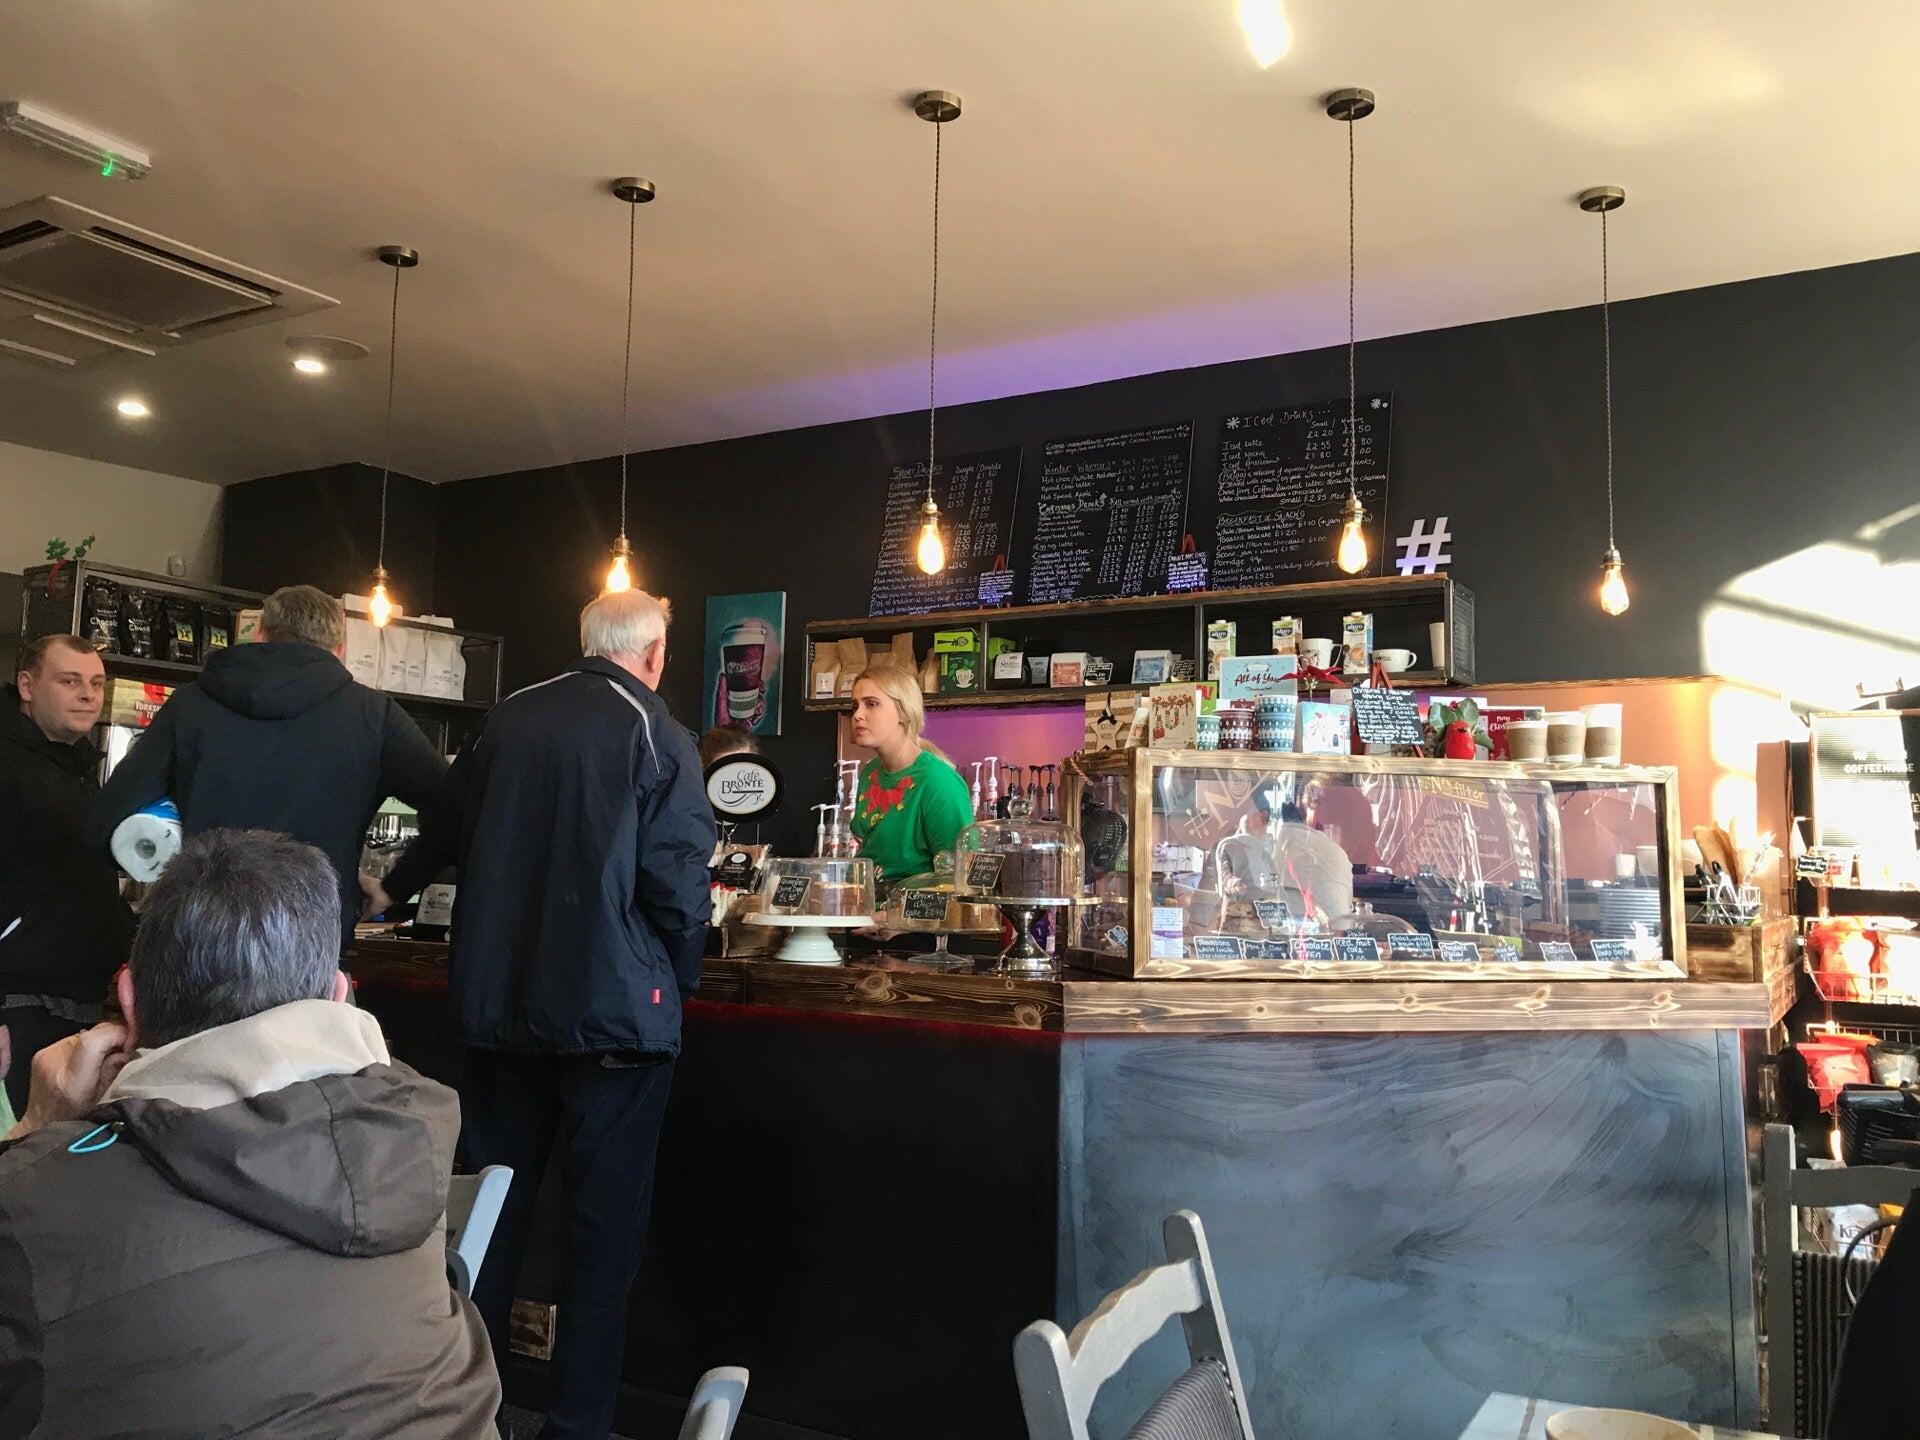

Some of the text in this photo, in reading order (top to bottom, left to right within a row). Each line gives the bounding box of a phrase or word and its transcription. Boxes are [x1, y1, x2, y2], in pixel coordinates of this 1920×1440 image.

[1234, 673, 1250, 687] All
[1252, 673, 1261, 684] of
[1294, 940, 1331, 951] Chocolate
